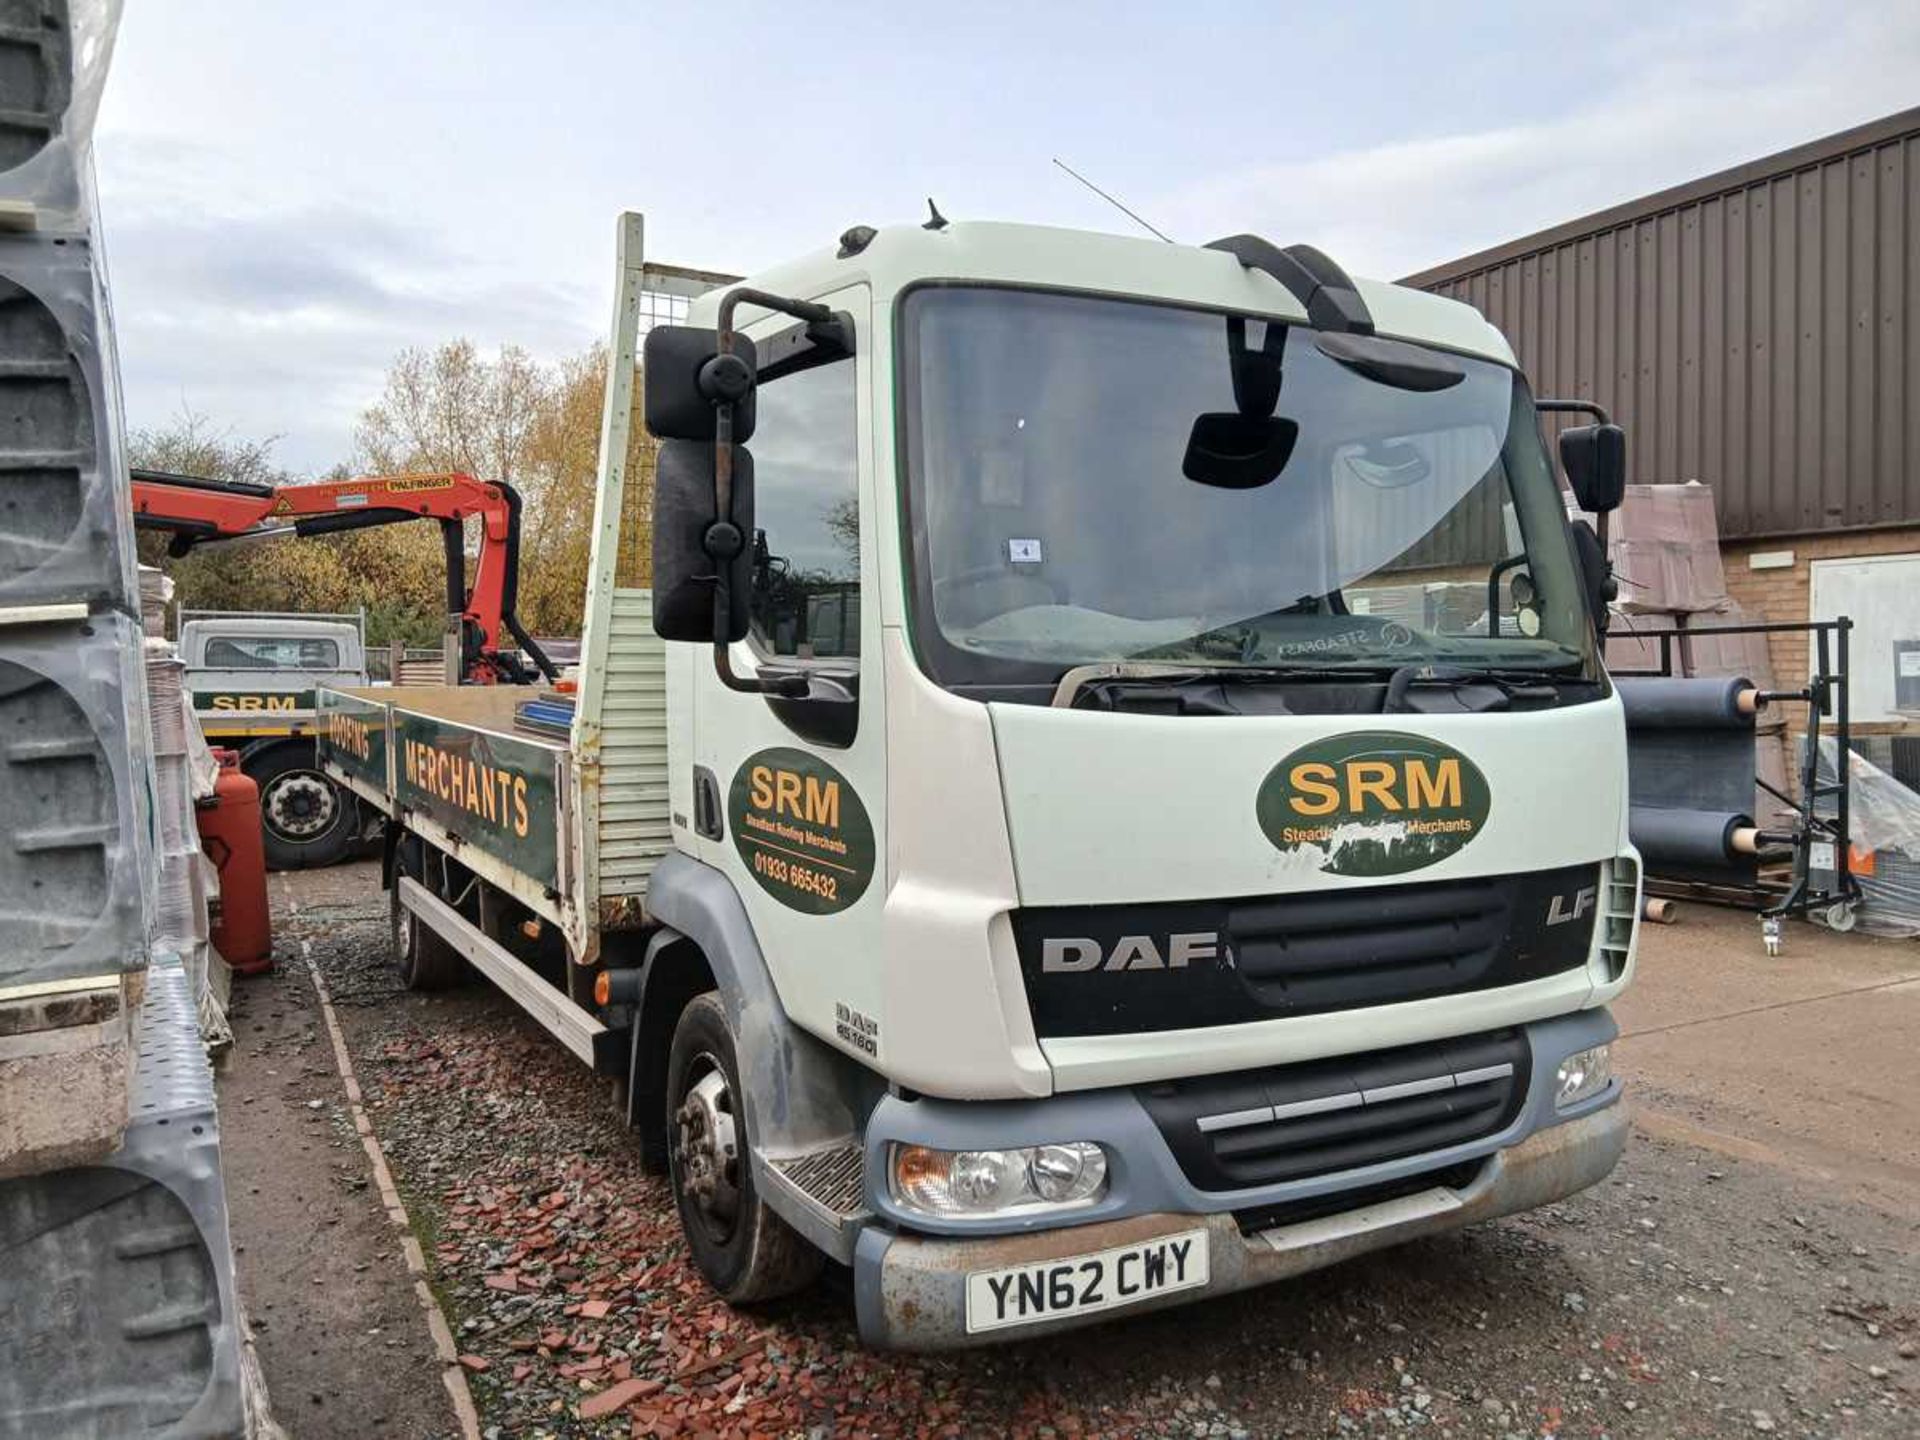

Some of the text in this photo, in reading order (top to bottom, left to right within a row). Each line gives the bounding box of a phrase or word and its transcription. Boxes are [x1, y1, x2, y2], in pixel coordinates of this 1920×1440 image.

[389, 476, 451, 491] PALFINGER
[211, 696, 296, 713] SRM
[405, 738, 528, 838] MERCHANTS
[750, 765, 840, 829] SRM
[1288, 758, 1463, 815] SRM
[805, 830, 847, 855] Merchants
[1406, 818, 1472, 836] Merchants
[754, 850, 837, 900] 01933 665432
[1546, 885, 1597, 926] LF
[1043, 932, 1218, 973] DAF
[986, 1238, 1192, 1320] YN62 CWY
